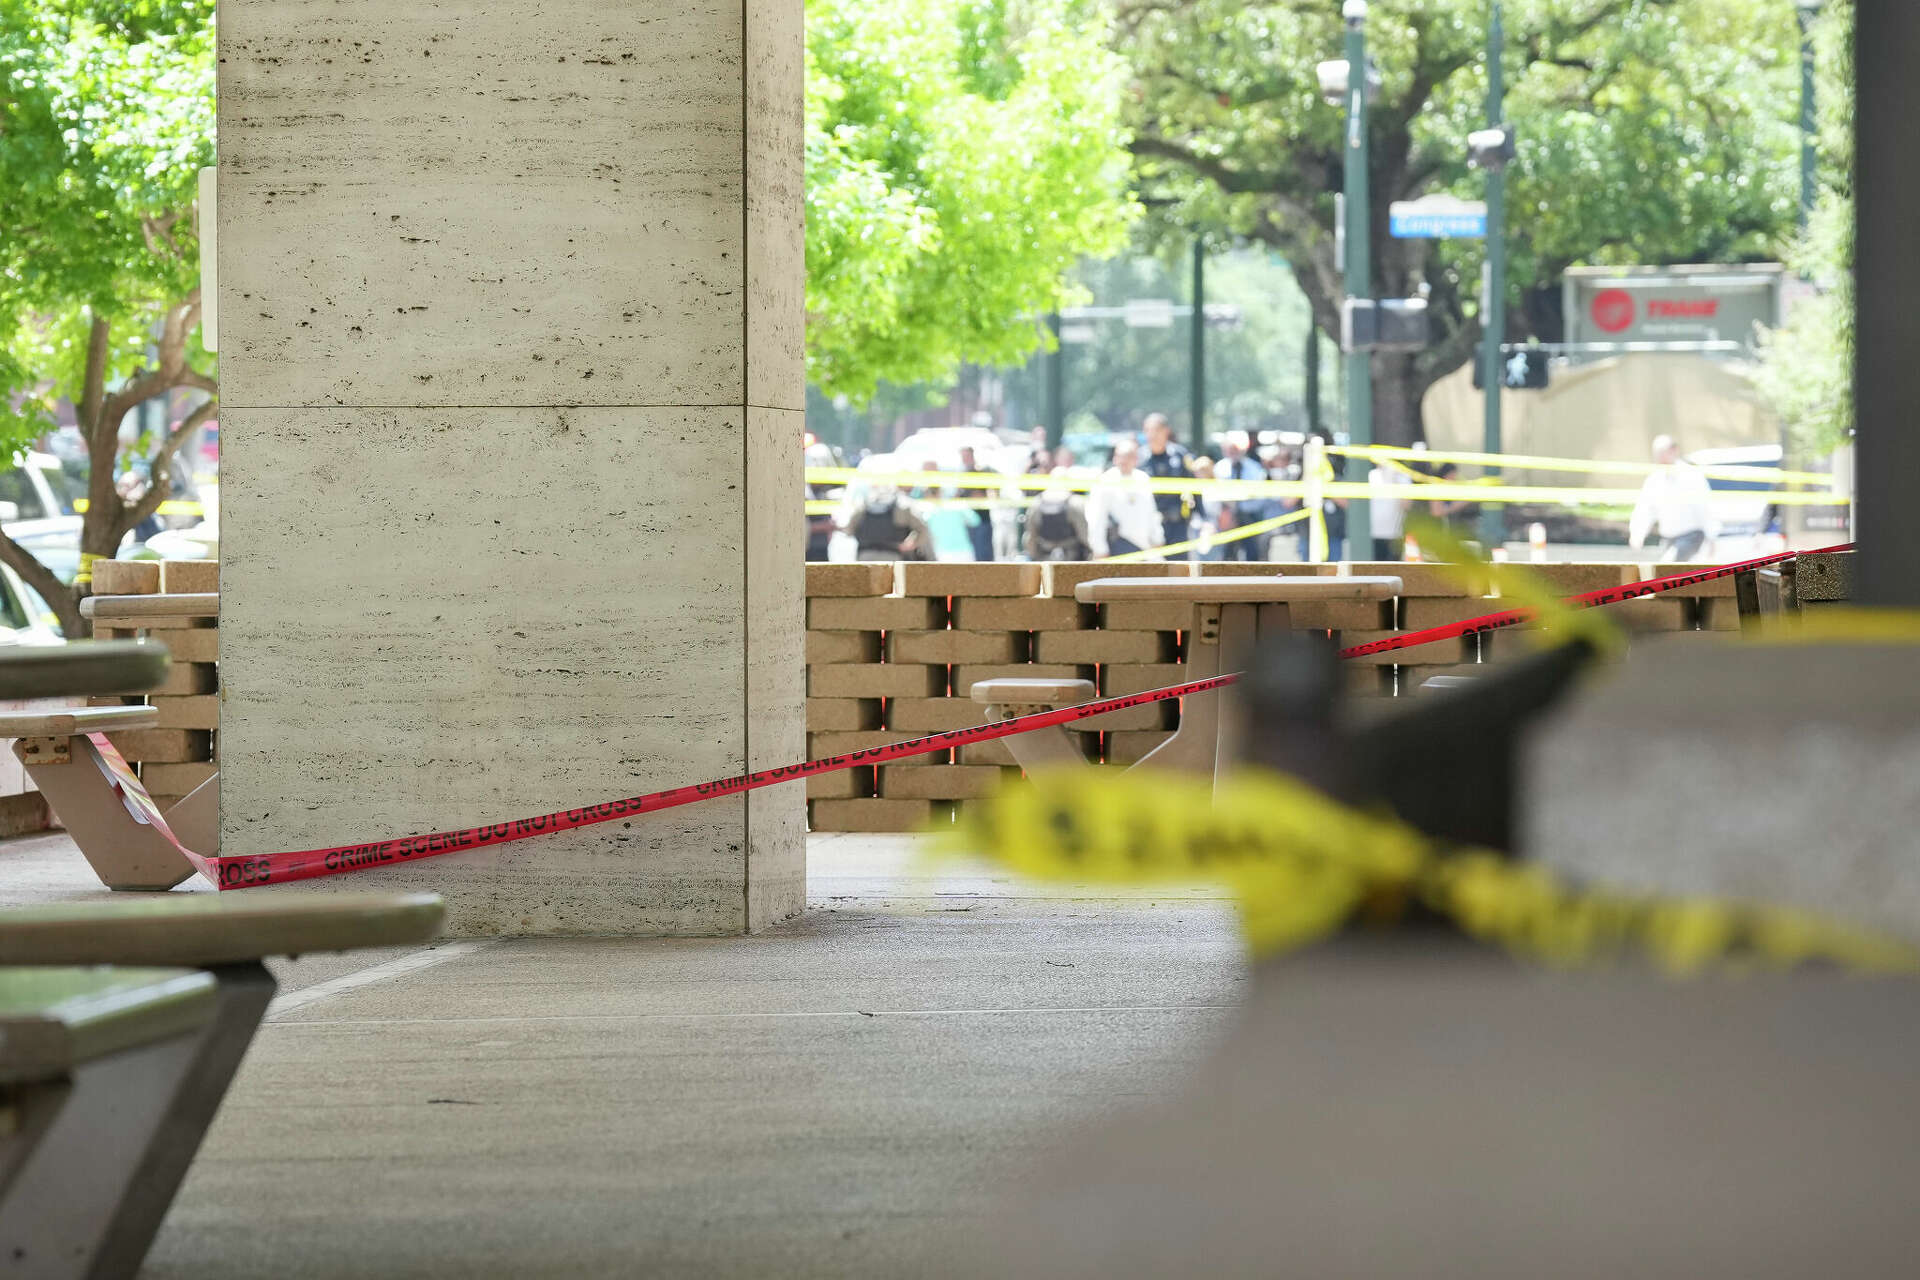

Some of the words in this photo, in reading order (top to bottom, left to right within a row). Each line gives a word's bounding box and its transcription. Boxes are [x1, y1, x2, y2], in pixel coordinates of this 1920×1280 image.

[324, 842, 393, 870] CRIME
[399, 829, 472, 857] SCENE
[478, 822, 509, 842] DO
[516, 813, 560, 834] NOT
[567, 797, 642, 823] CROSS
